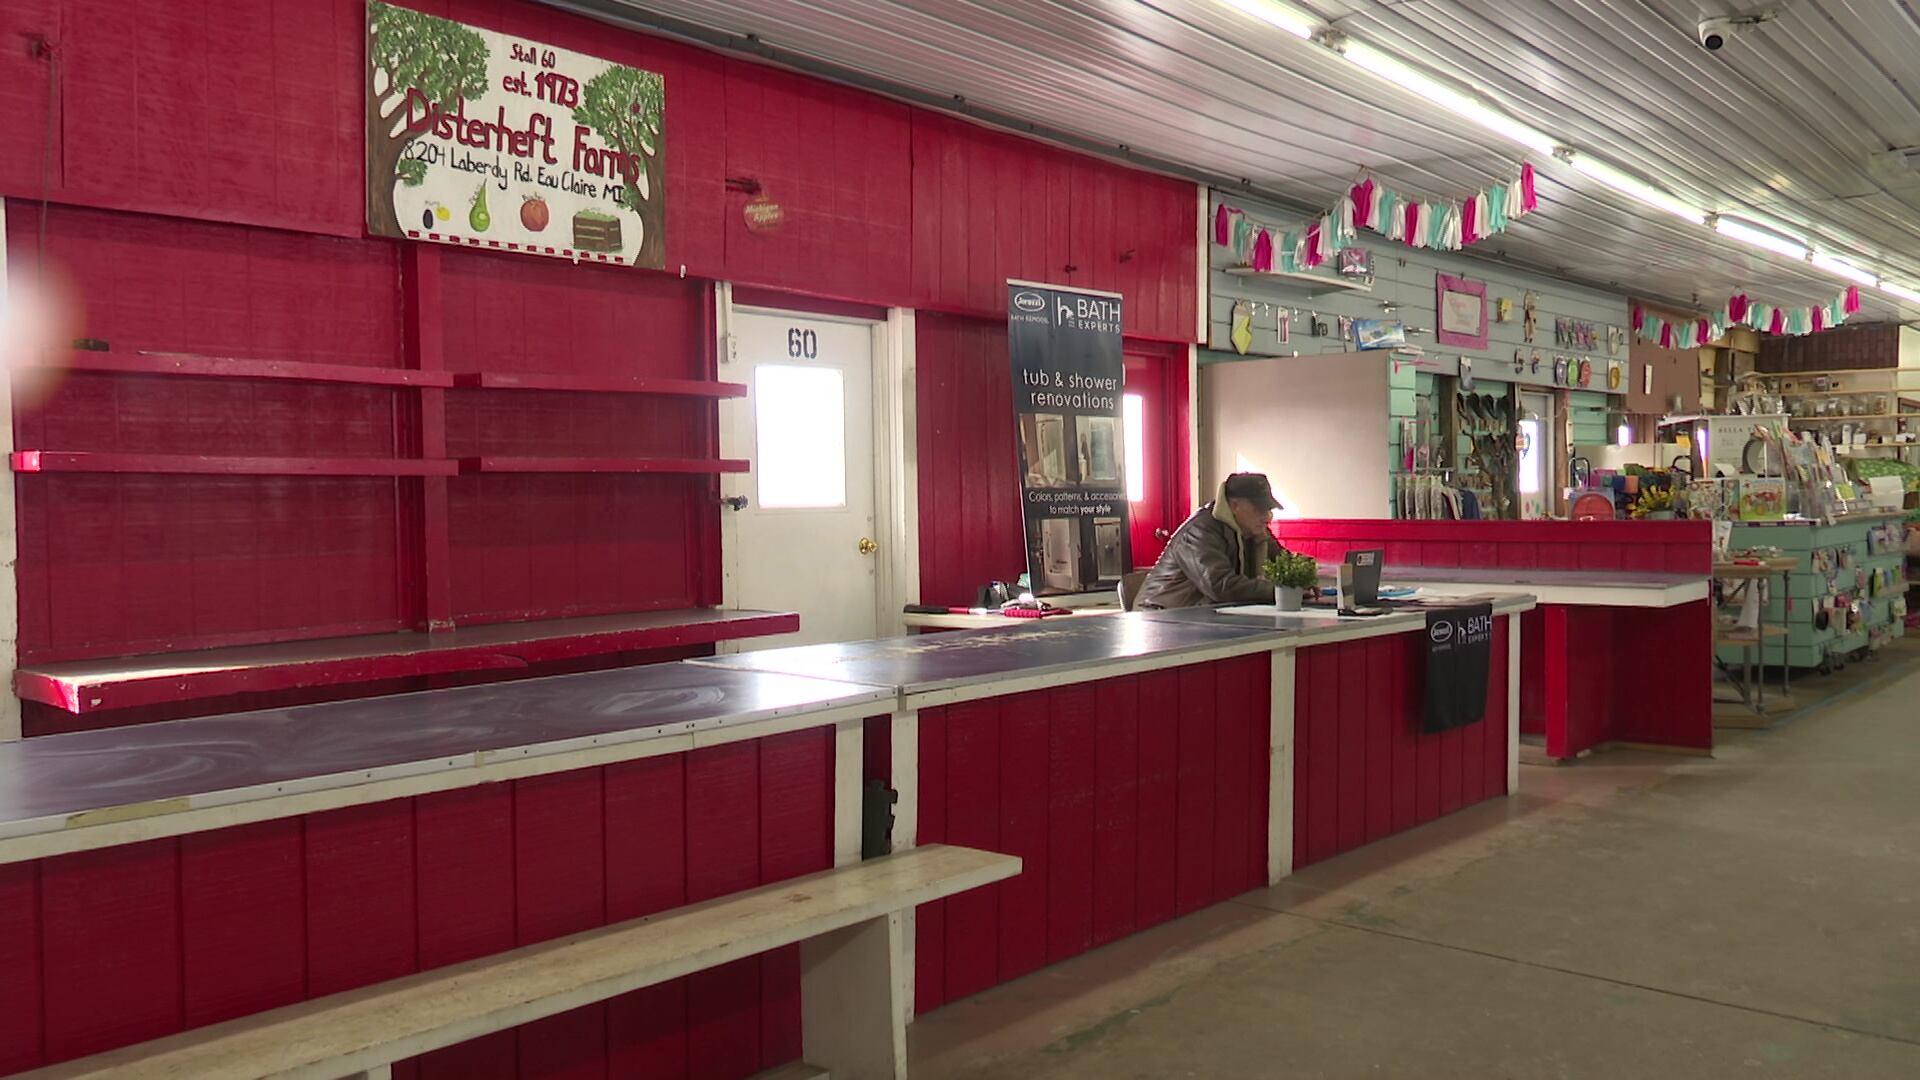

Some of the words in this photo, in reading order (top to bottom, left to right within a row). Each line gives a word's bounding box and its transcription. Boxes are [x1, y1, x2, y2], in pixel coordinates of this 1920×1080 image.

[510, 43, 537, 66] Stall
[541, 49, 556, 69] 60
[503, 71, 532, 98] est.
[534, 71, 579, 108] 1973
[406, 87, 558, 164] Disterheft
[572, 125, 641, 186] Farms
[404, 140, 446, 167] 8204
[451, 147, 508, 190] Laberdy
[514, 161, 533, 183] Rd.
[537, 166, 559, 189] Eau
[561, 171, 597, 198] Claire
[603, 184, 625, 203] MI
[1077, 298, 1120, 322] BATH
[1078, 320, 1120, 334] EXPERTS
[788, 328, 817, 359] 60
[1023, 368, 1049, 386] tub
[1055, 371, 1064, 387] &
[1069, 372, 1117, 390] shower
[1031, 392, 1114, 409] renovations
[1049, 505, 1057, 514] to
[1058, 504, 1079, 514] match
[1080, 507, 1095, 516] your
[1096, 503, 1111, 515] style
[1467, 616, 1492, 634] BATH
